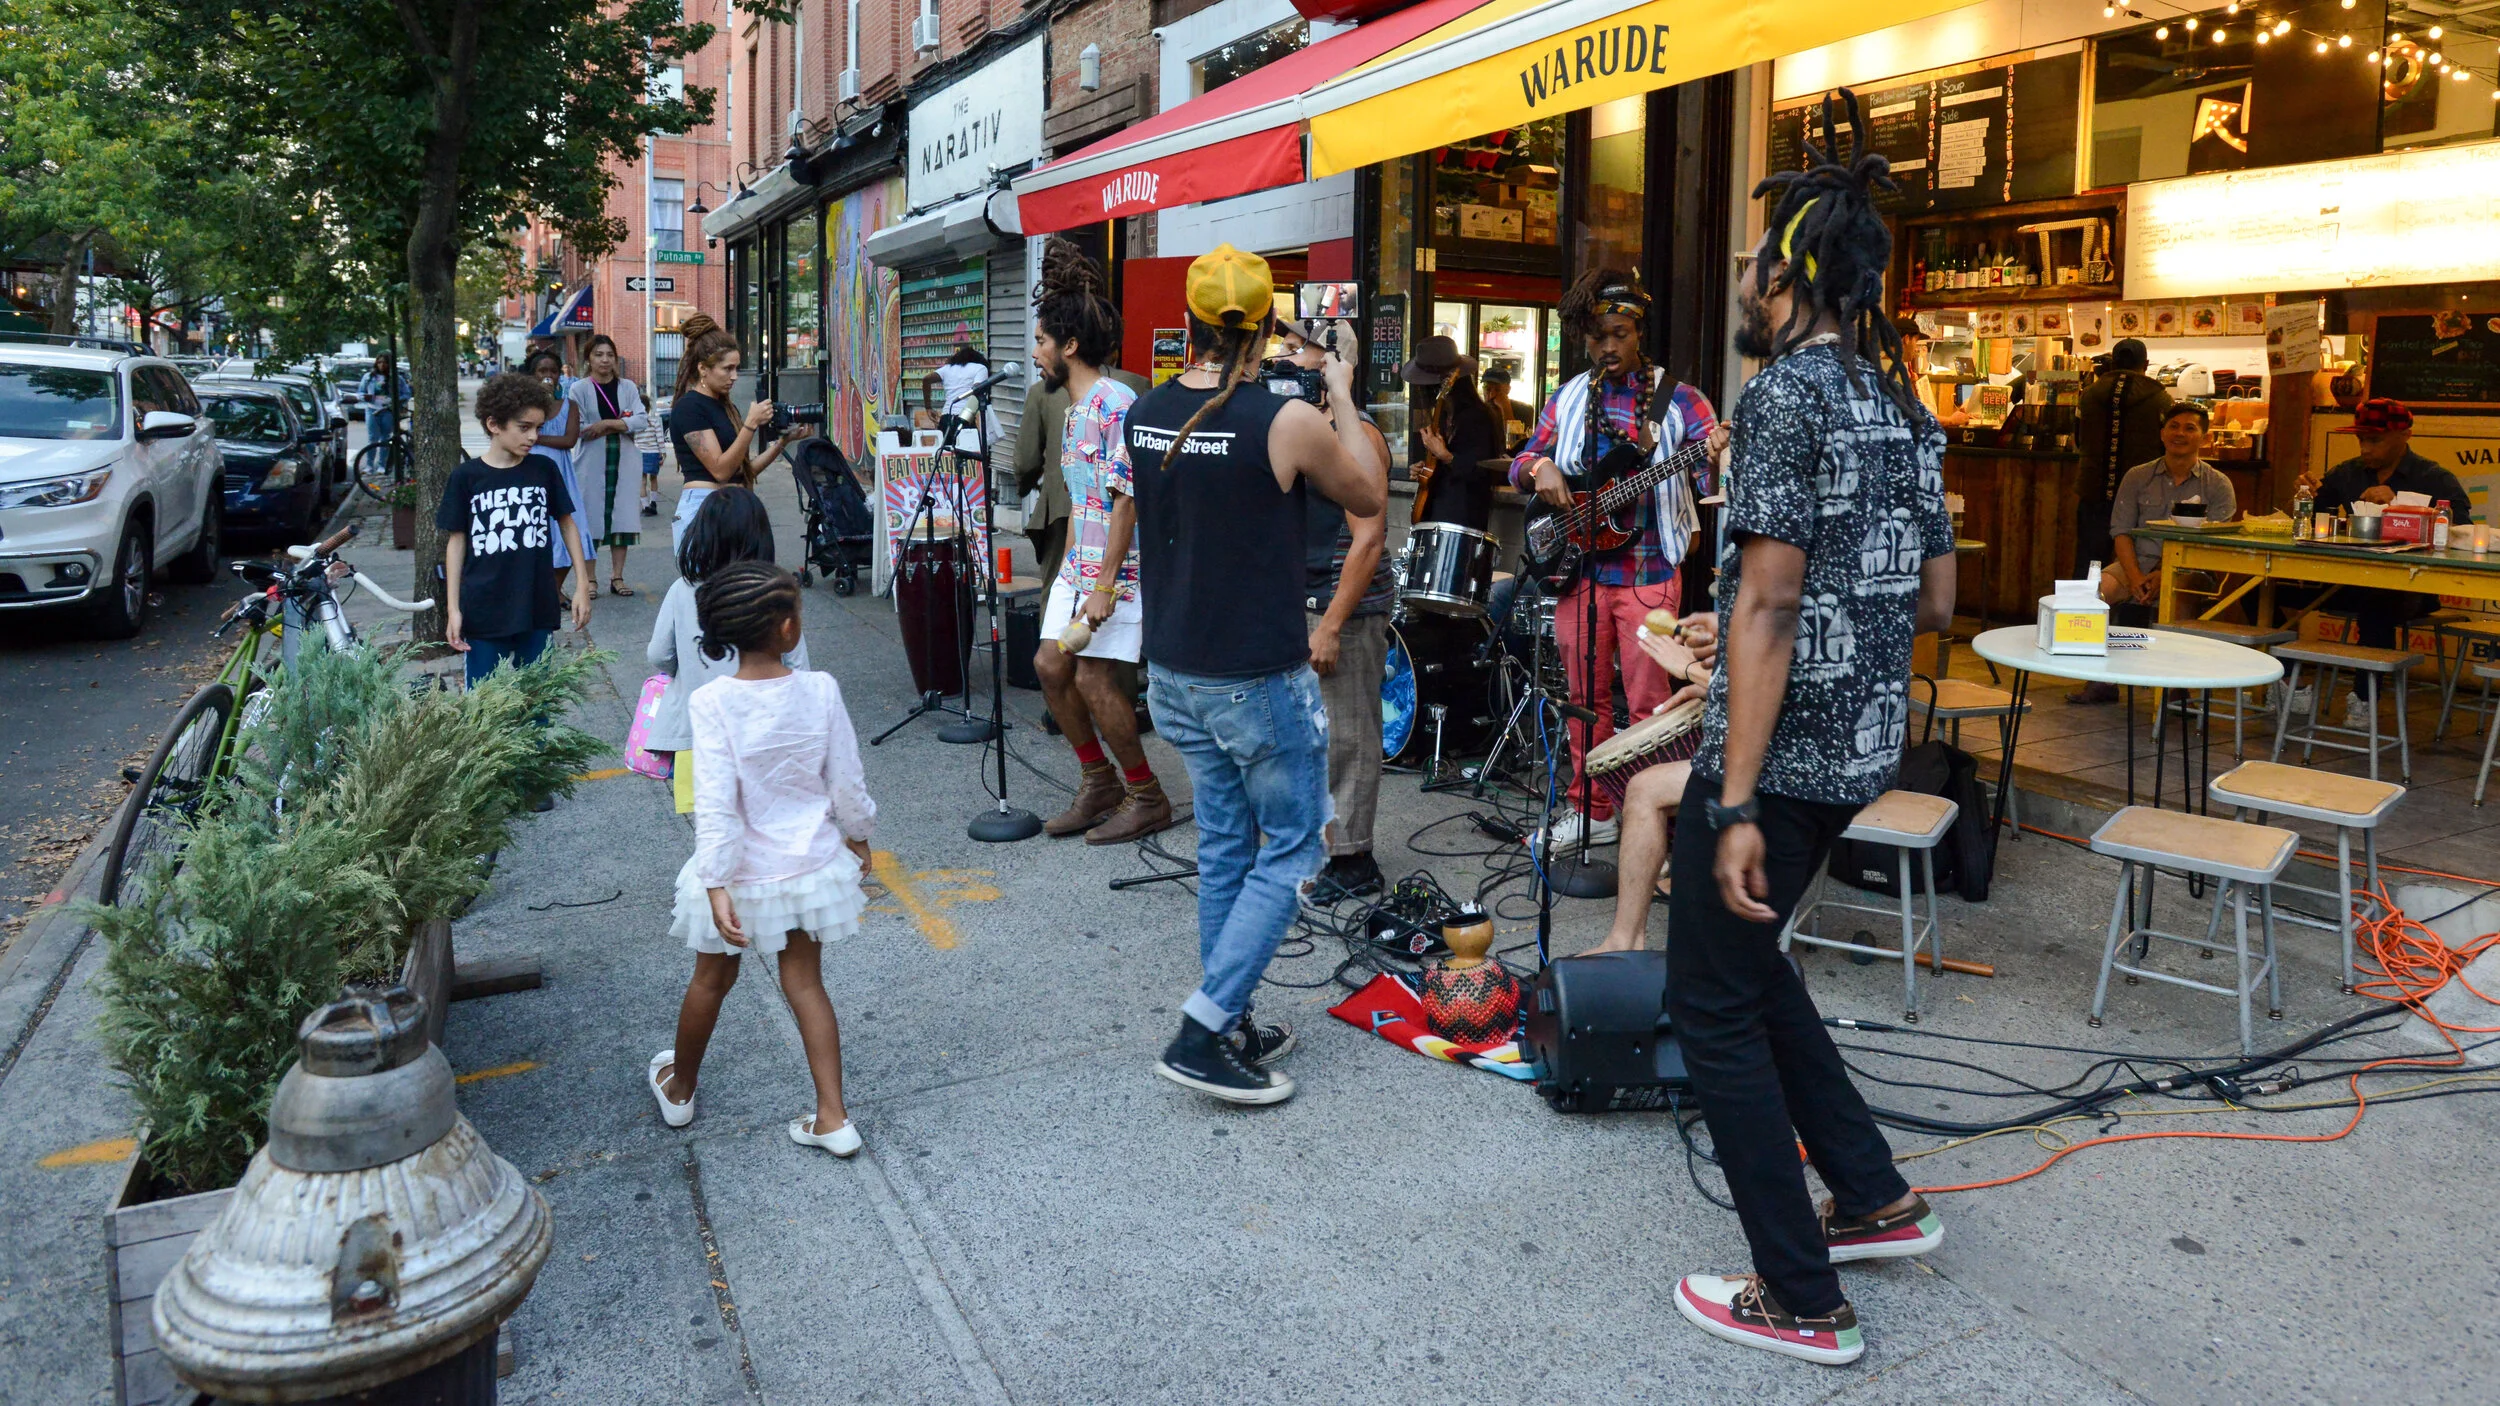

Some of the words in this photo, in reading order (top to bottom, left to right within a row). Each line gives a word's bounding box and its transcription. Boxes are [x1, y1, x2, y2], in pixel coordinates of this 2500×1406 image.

[1520, 24, 1670, 108] WARUDE
[1941, 80, 1965, 94] Soup
[953, 97, 969, 119] THE
[1940, 109, 1960, 123] Side
[922, 108, 1002, 176] NARATIV
[1102, 171, 1160, 213] WARUDE
[658, 251, 692, 262] Putnam
[1373, 317, 1402, 326] MATCHA
[1373, 326, 1401, 341] BEER
[1372, 349, 1401, 364] HERE
[1983, 396, 2007, 405] BEER
[1181, 437, 1229, 455] Street
[2456, 449, 2500, 466] WA
[885, 456, 912, 483] EAT
[470, 486, 547, 514] THERE'S
[471, 515, 486, 536] A
[489, 505, 547, 531] PLACE
[472, 528, 518, 557] FOR
[523, 526, 547, 549] US
[2068, 619, 2092, 629] TACO
